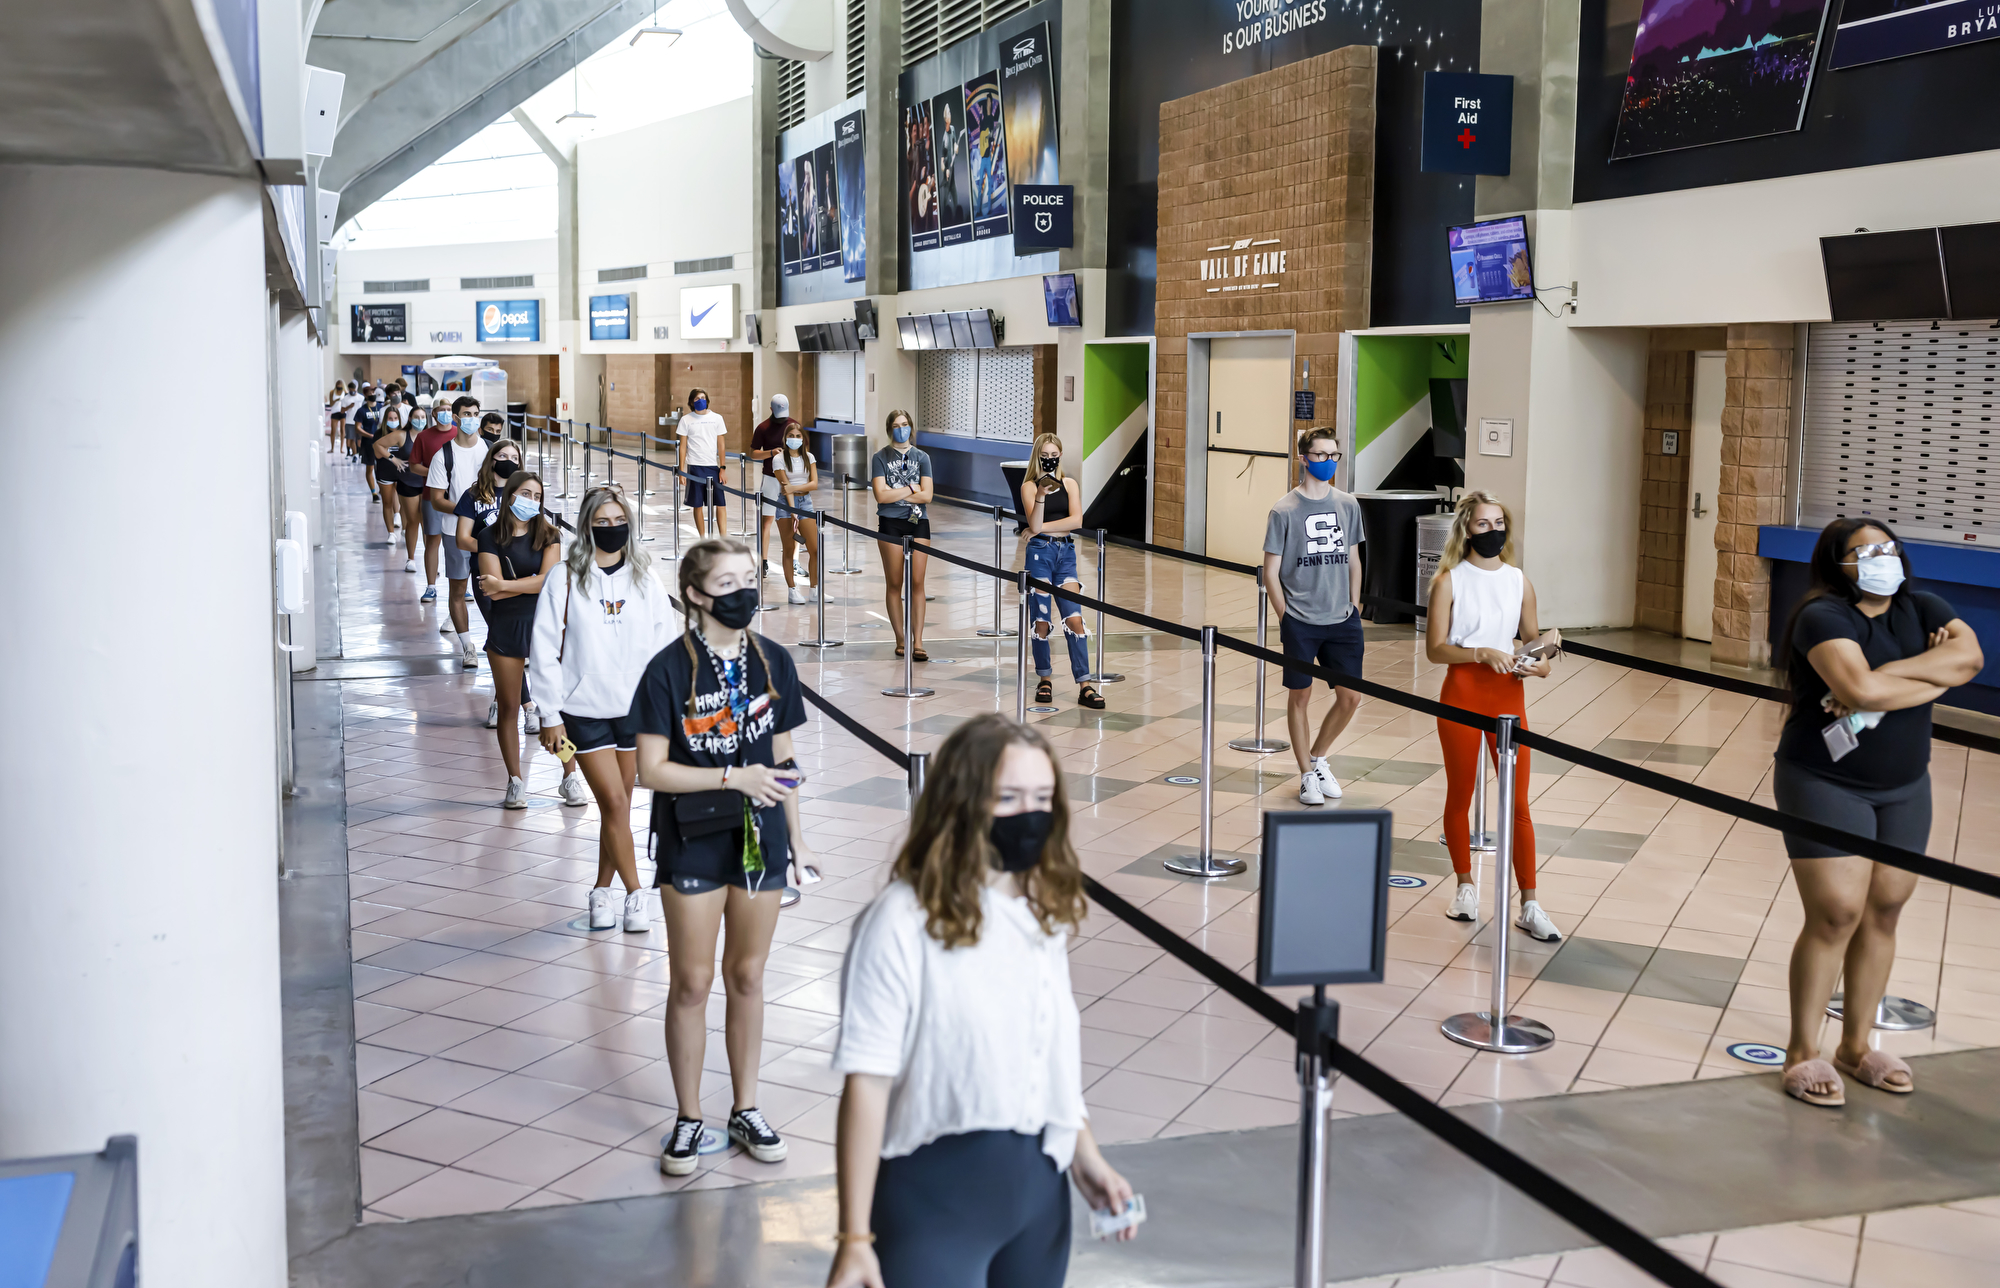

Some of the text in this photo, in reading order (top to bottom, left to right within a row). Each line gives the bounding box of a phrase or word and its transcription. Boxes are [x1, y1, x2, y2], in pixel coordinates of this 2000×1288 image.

[1236, 0, 1270, 22] YOUR
[1223, 0, 1327, 55] IS OUR BUSINESS
[1454, 96, 1481, 109] First
[1457, 112, 1478, 124] Aid
[1023, 194, 1064, 205] POLICE
[1200, 250, 1287, 281] WALL OF GAME
[501, 310, 529, 327] pepsi
[429, 331, 462, 343] WOMEN
[654, 326, 669, 340] MEN
[1296, 553, 1349, 567] PENN STATE
[750, 707, 775, 741] LIFE
